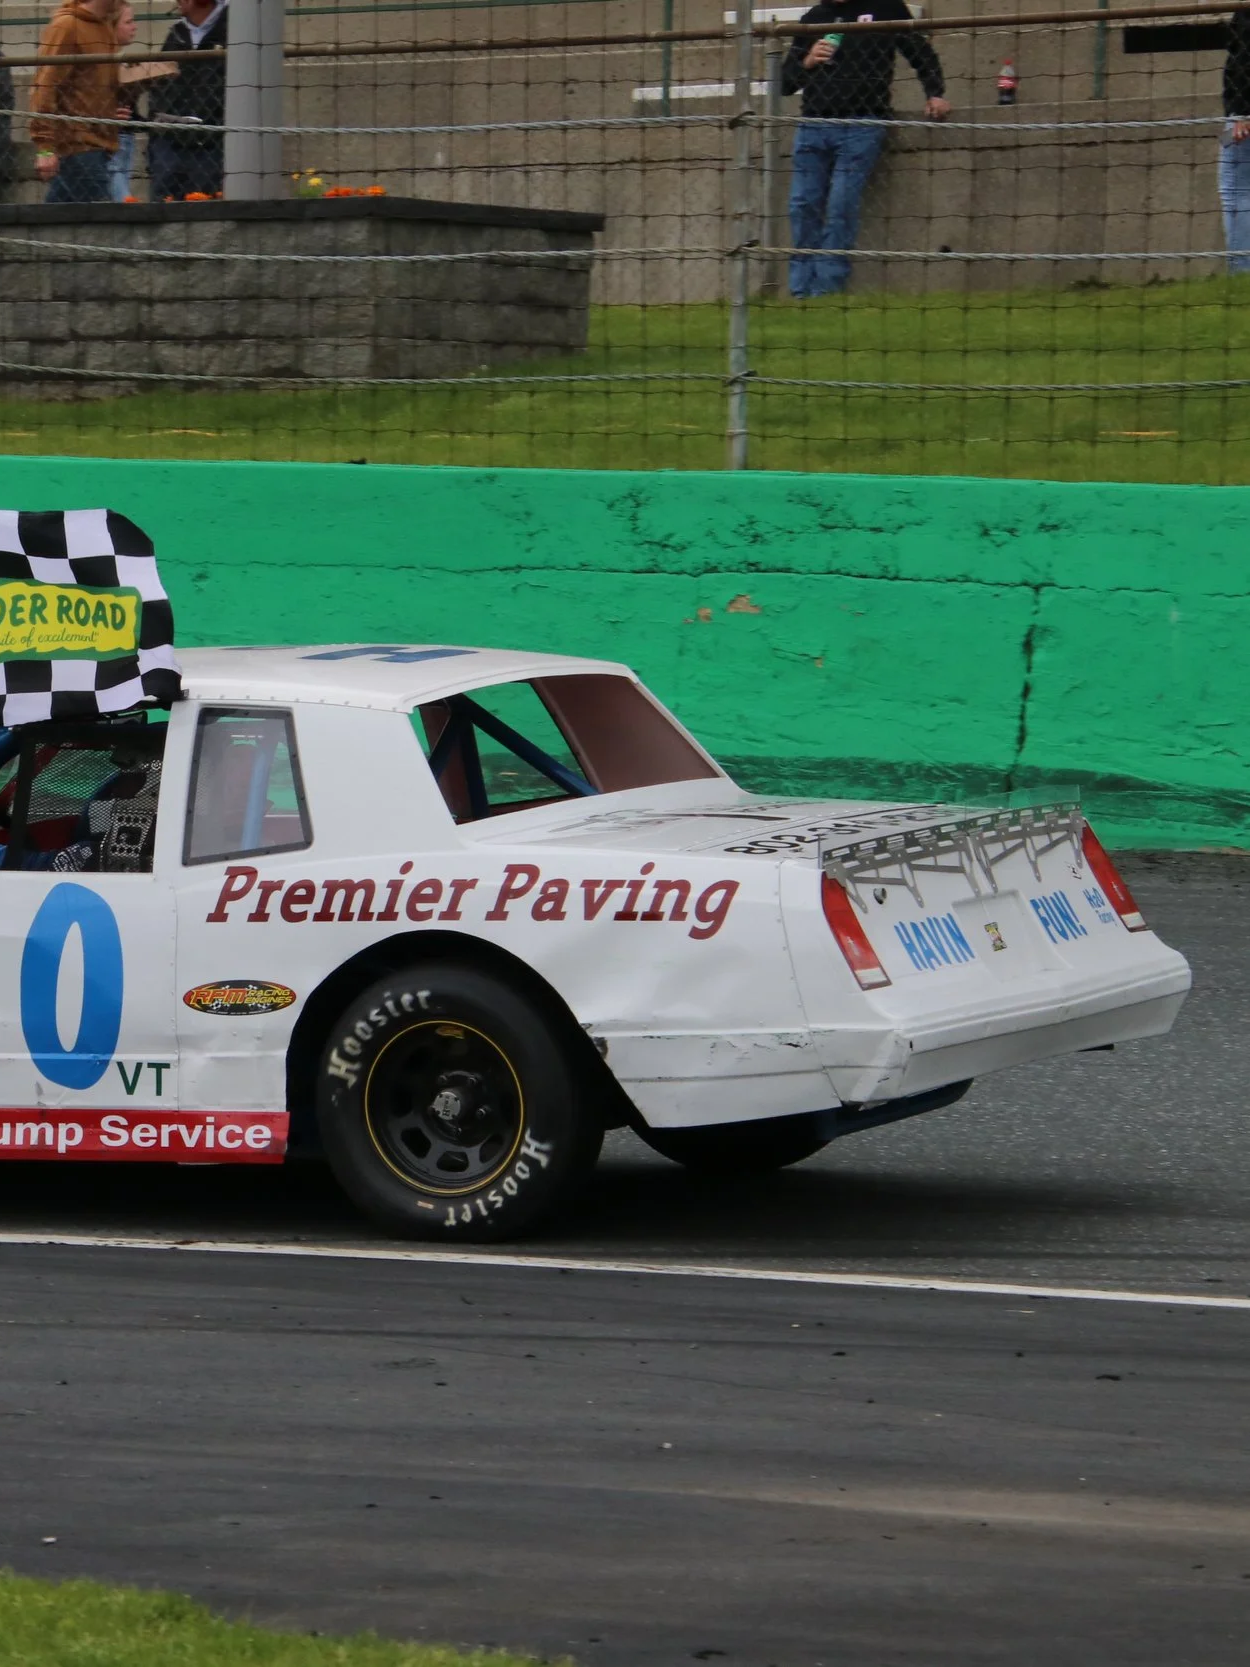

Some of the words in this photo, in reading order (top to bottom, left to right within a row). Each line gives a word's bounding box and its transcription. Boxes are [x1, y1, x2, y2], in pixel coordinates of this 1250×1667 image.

[56, 596, 126, 631] ROAD
[20, 629, 33, 650] of
[205, 860, 479, 923] Premier
[484, 862, 740, 940] Paving
[893, 912, 975, 971] HAVIN
[1030, 890, 1088, 944] FUN!
[190, 989, 248, 1004] RPM
[328, 990, 432, 1089] Hoosier
[116, 1061, 171, 1097] VT
[100, 1115, 271, 1149] Service
[443, 1127, 552, 1227] Hoosier
